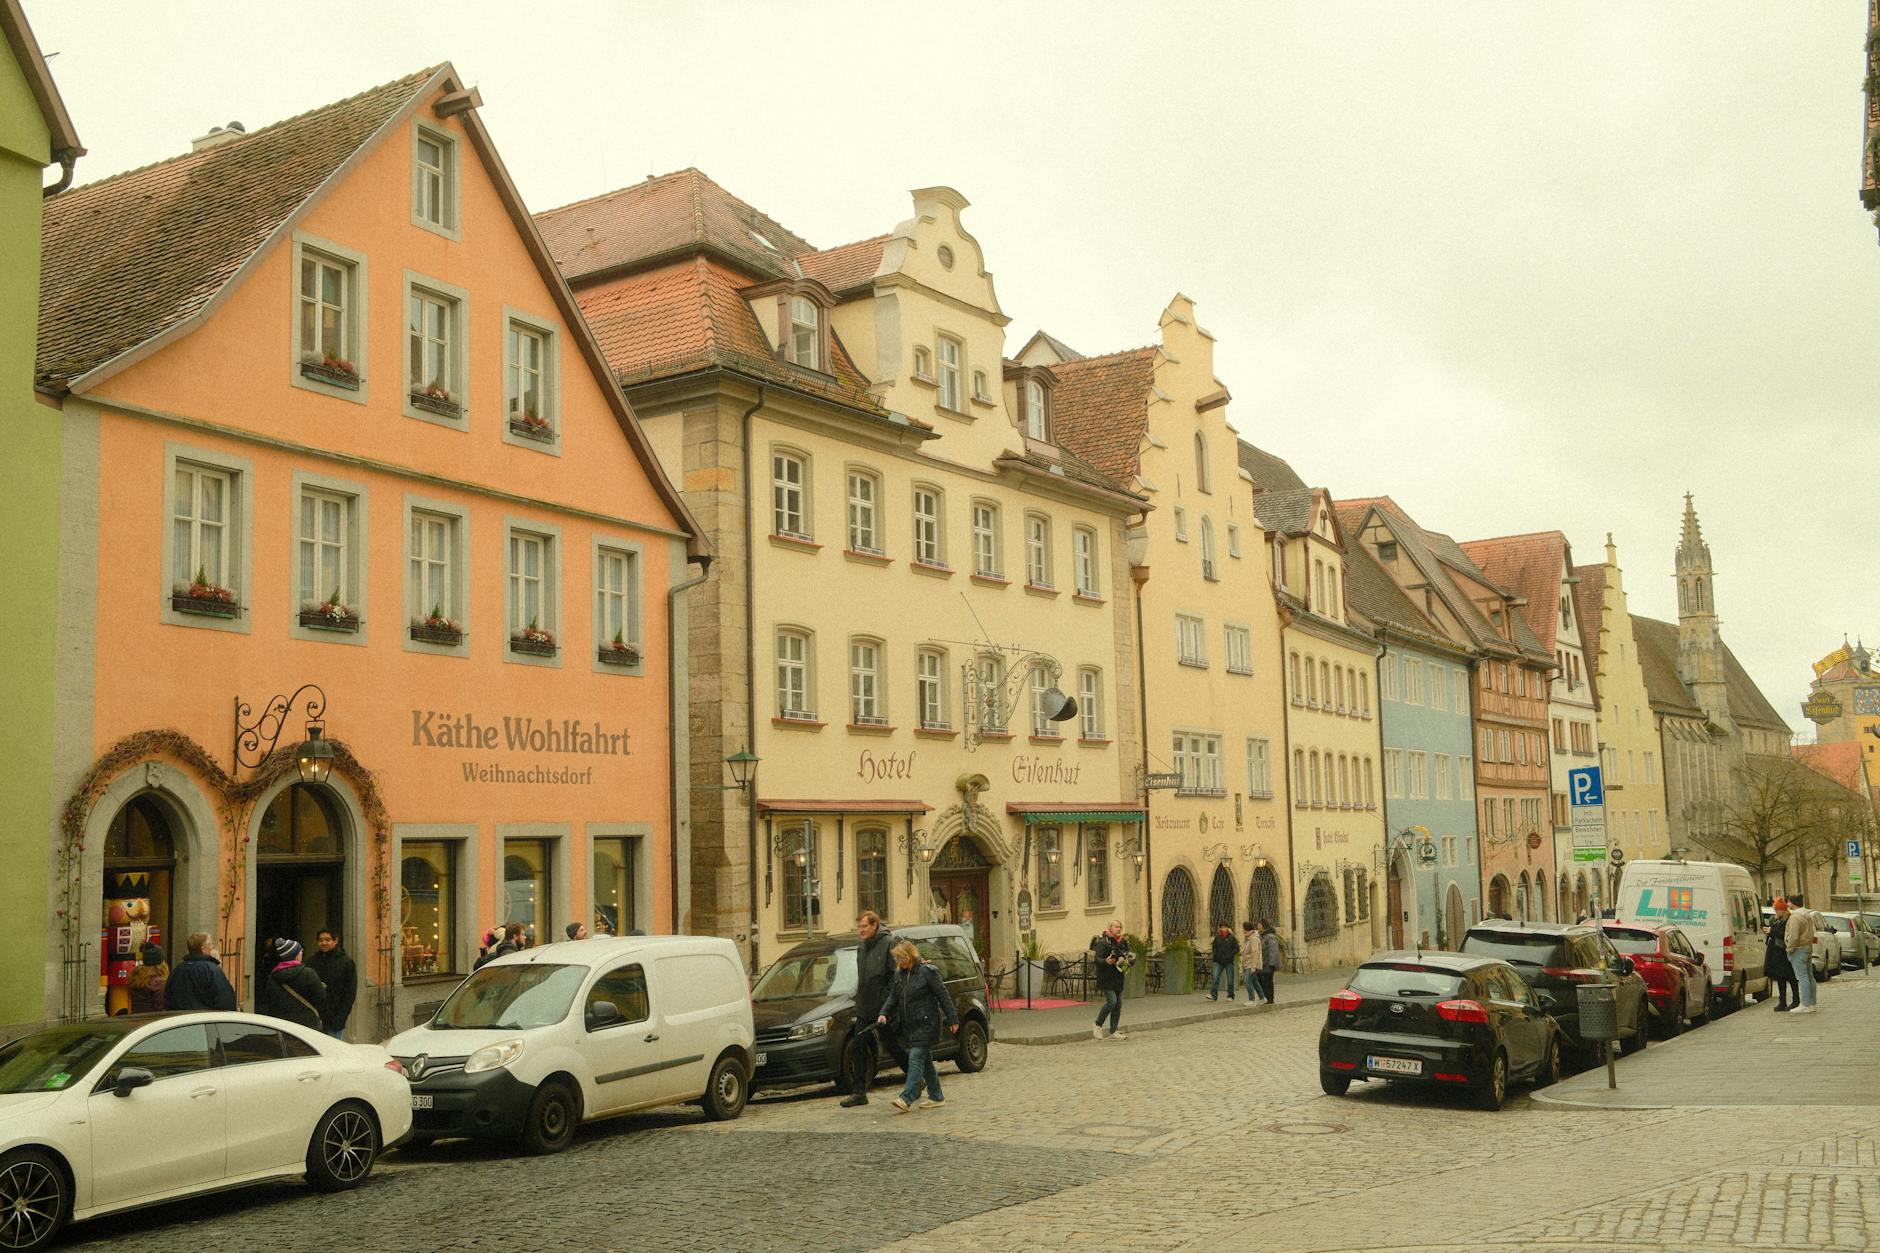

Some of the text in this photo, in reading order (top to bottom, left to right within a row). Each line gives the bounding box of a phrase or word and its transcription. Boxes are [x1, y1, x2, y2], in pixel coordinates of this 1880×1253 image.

[412, 710, 631, 756] Käthe Wohlfahrt
[462, 762, 593, 784] Weihnachtsdorf
[857, 749, 916, 784] Hotel
[1145, 776, 1180, 787] Eisenhut
[1573, 773, 1592, 804] P
[1849, 843, 1857, 856] P
[419, 1097, 432, 1107] 300
